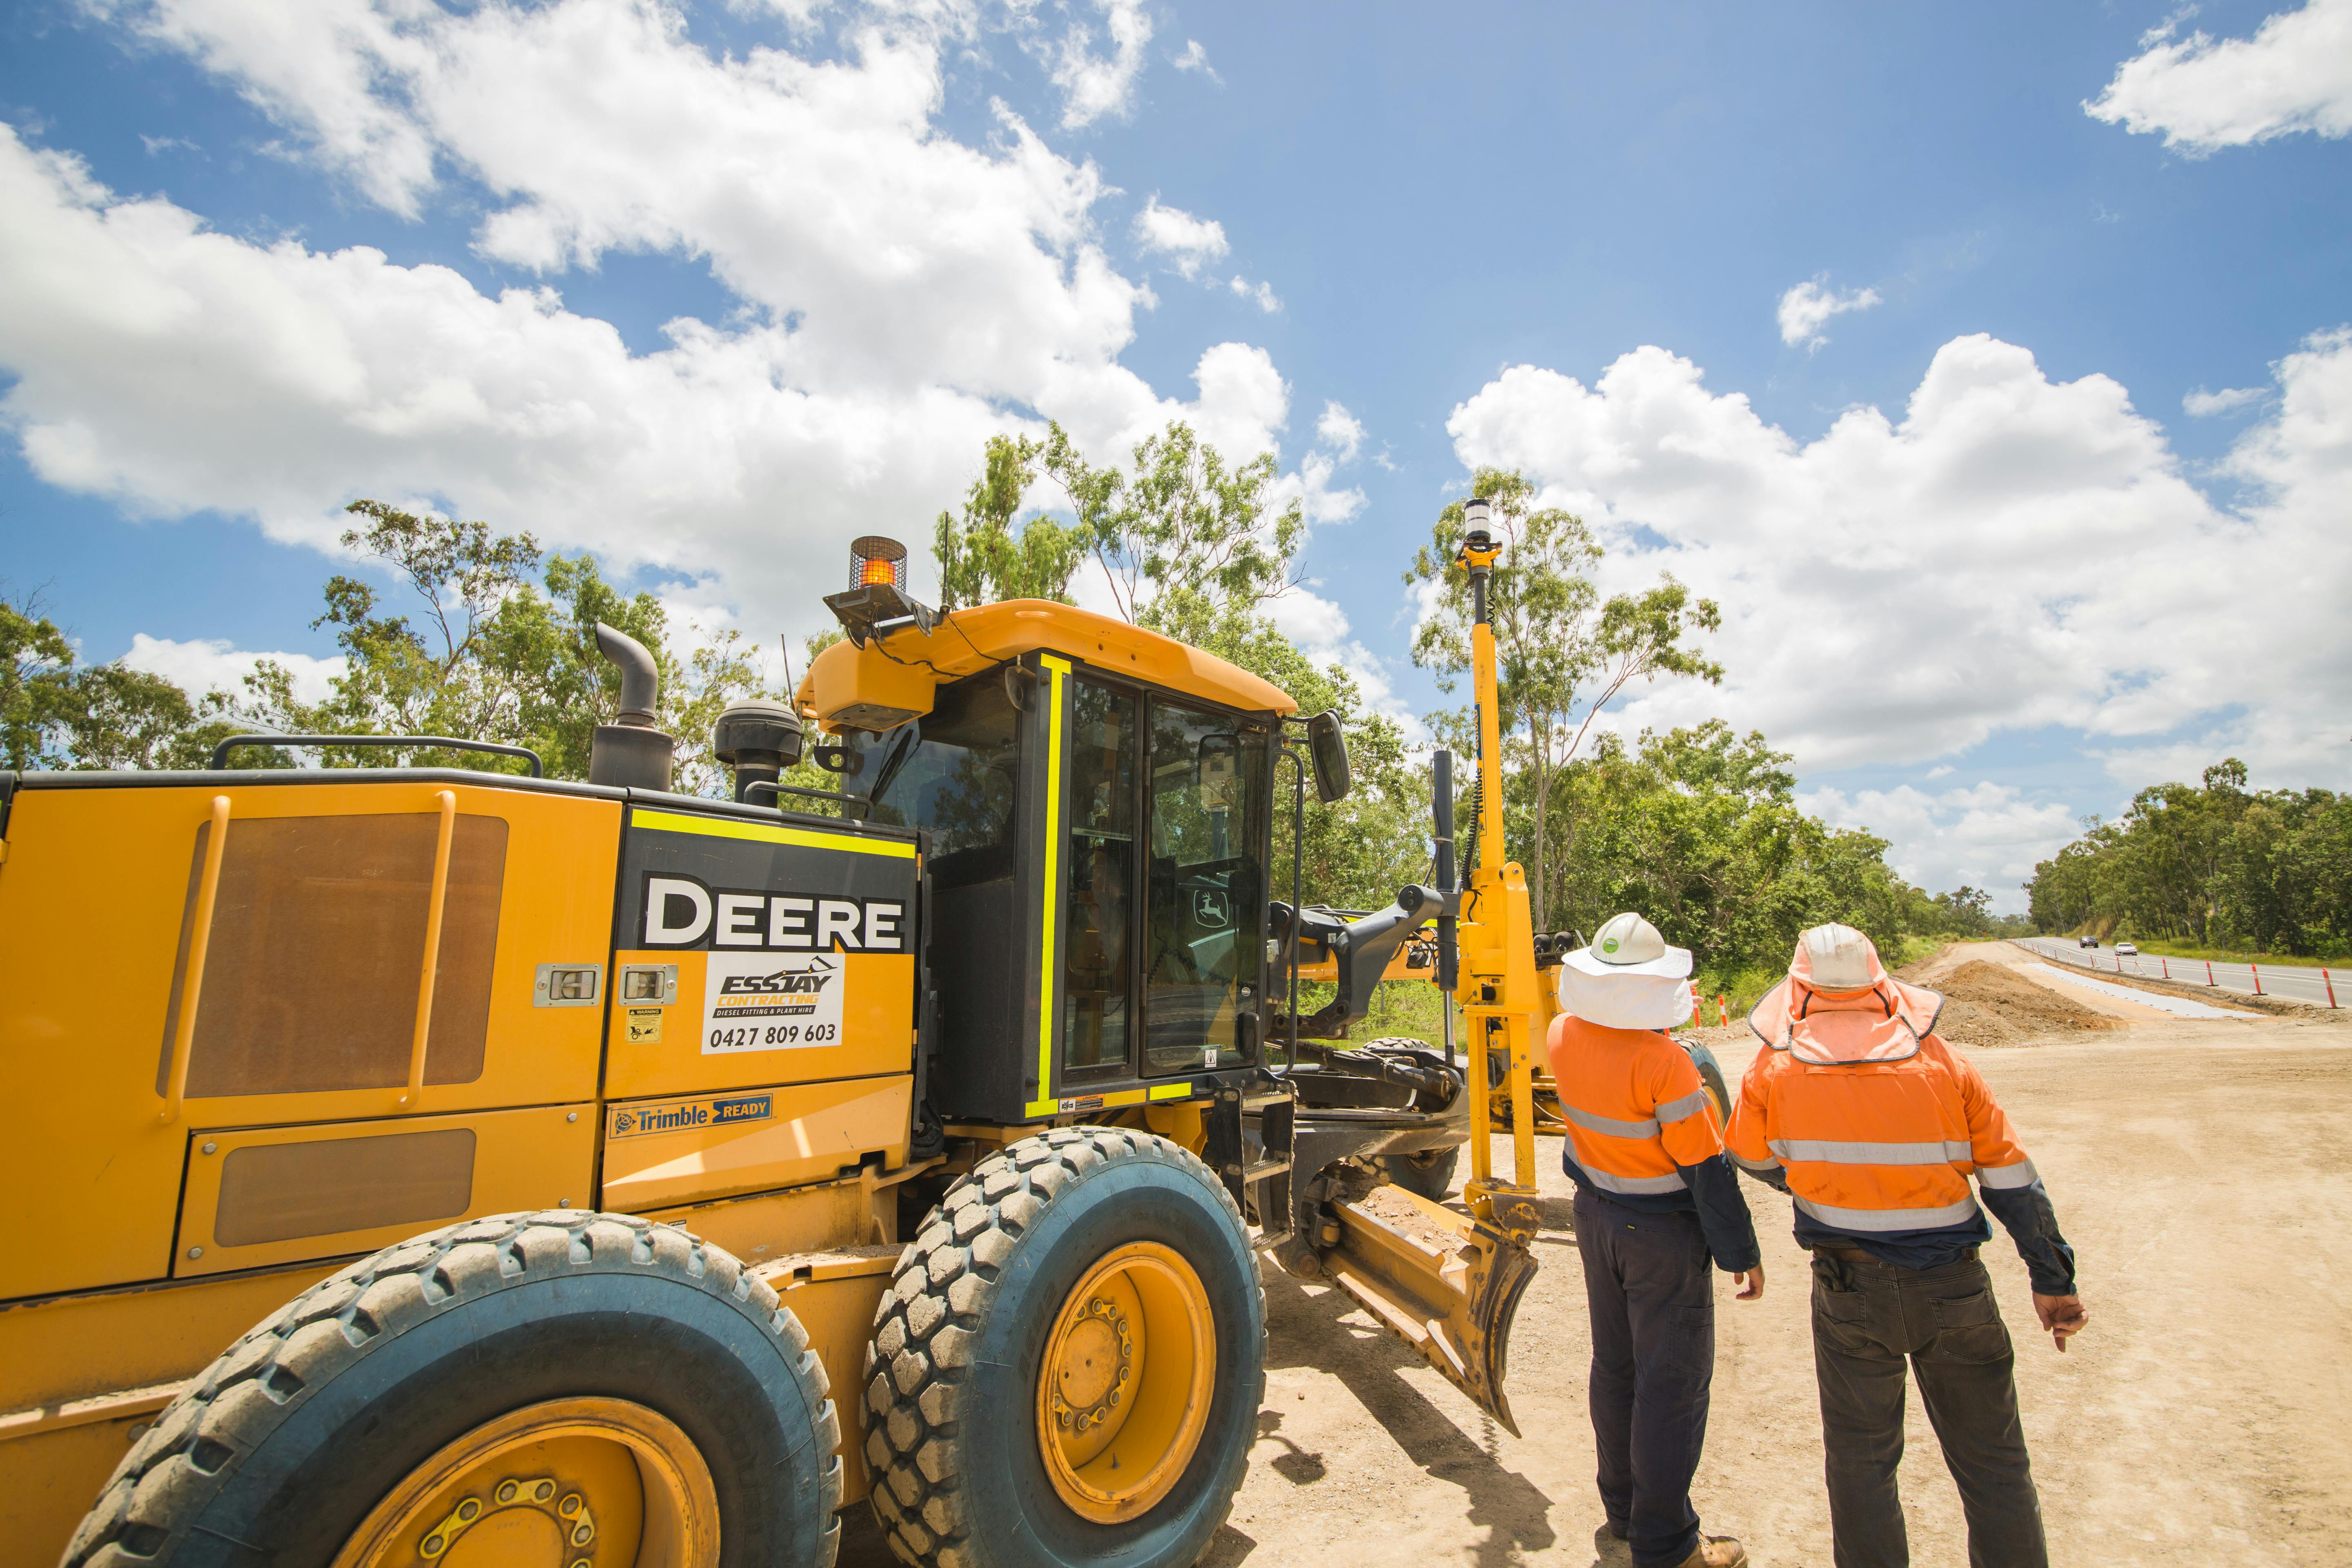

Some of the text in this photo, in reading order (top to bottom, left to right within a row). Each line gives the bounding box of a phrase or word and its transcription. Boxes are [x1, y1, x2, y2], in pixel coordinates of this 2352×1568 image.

[645, 878, 901, 949] DEERE
[720, 976, 832, 994] ESSJAY
[717, 994, 819, 1007] CONTRACTING
[710, 1024, 835, 1047] 0427 809 603
[637, 1105, 708, 1131] Trimble
[723, 1102, 767, 1118] READY
